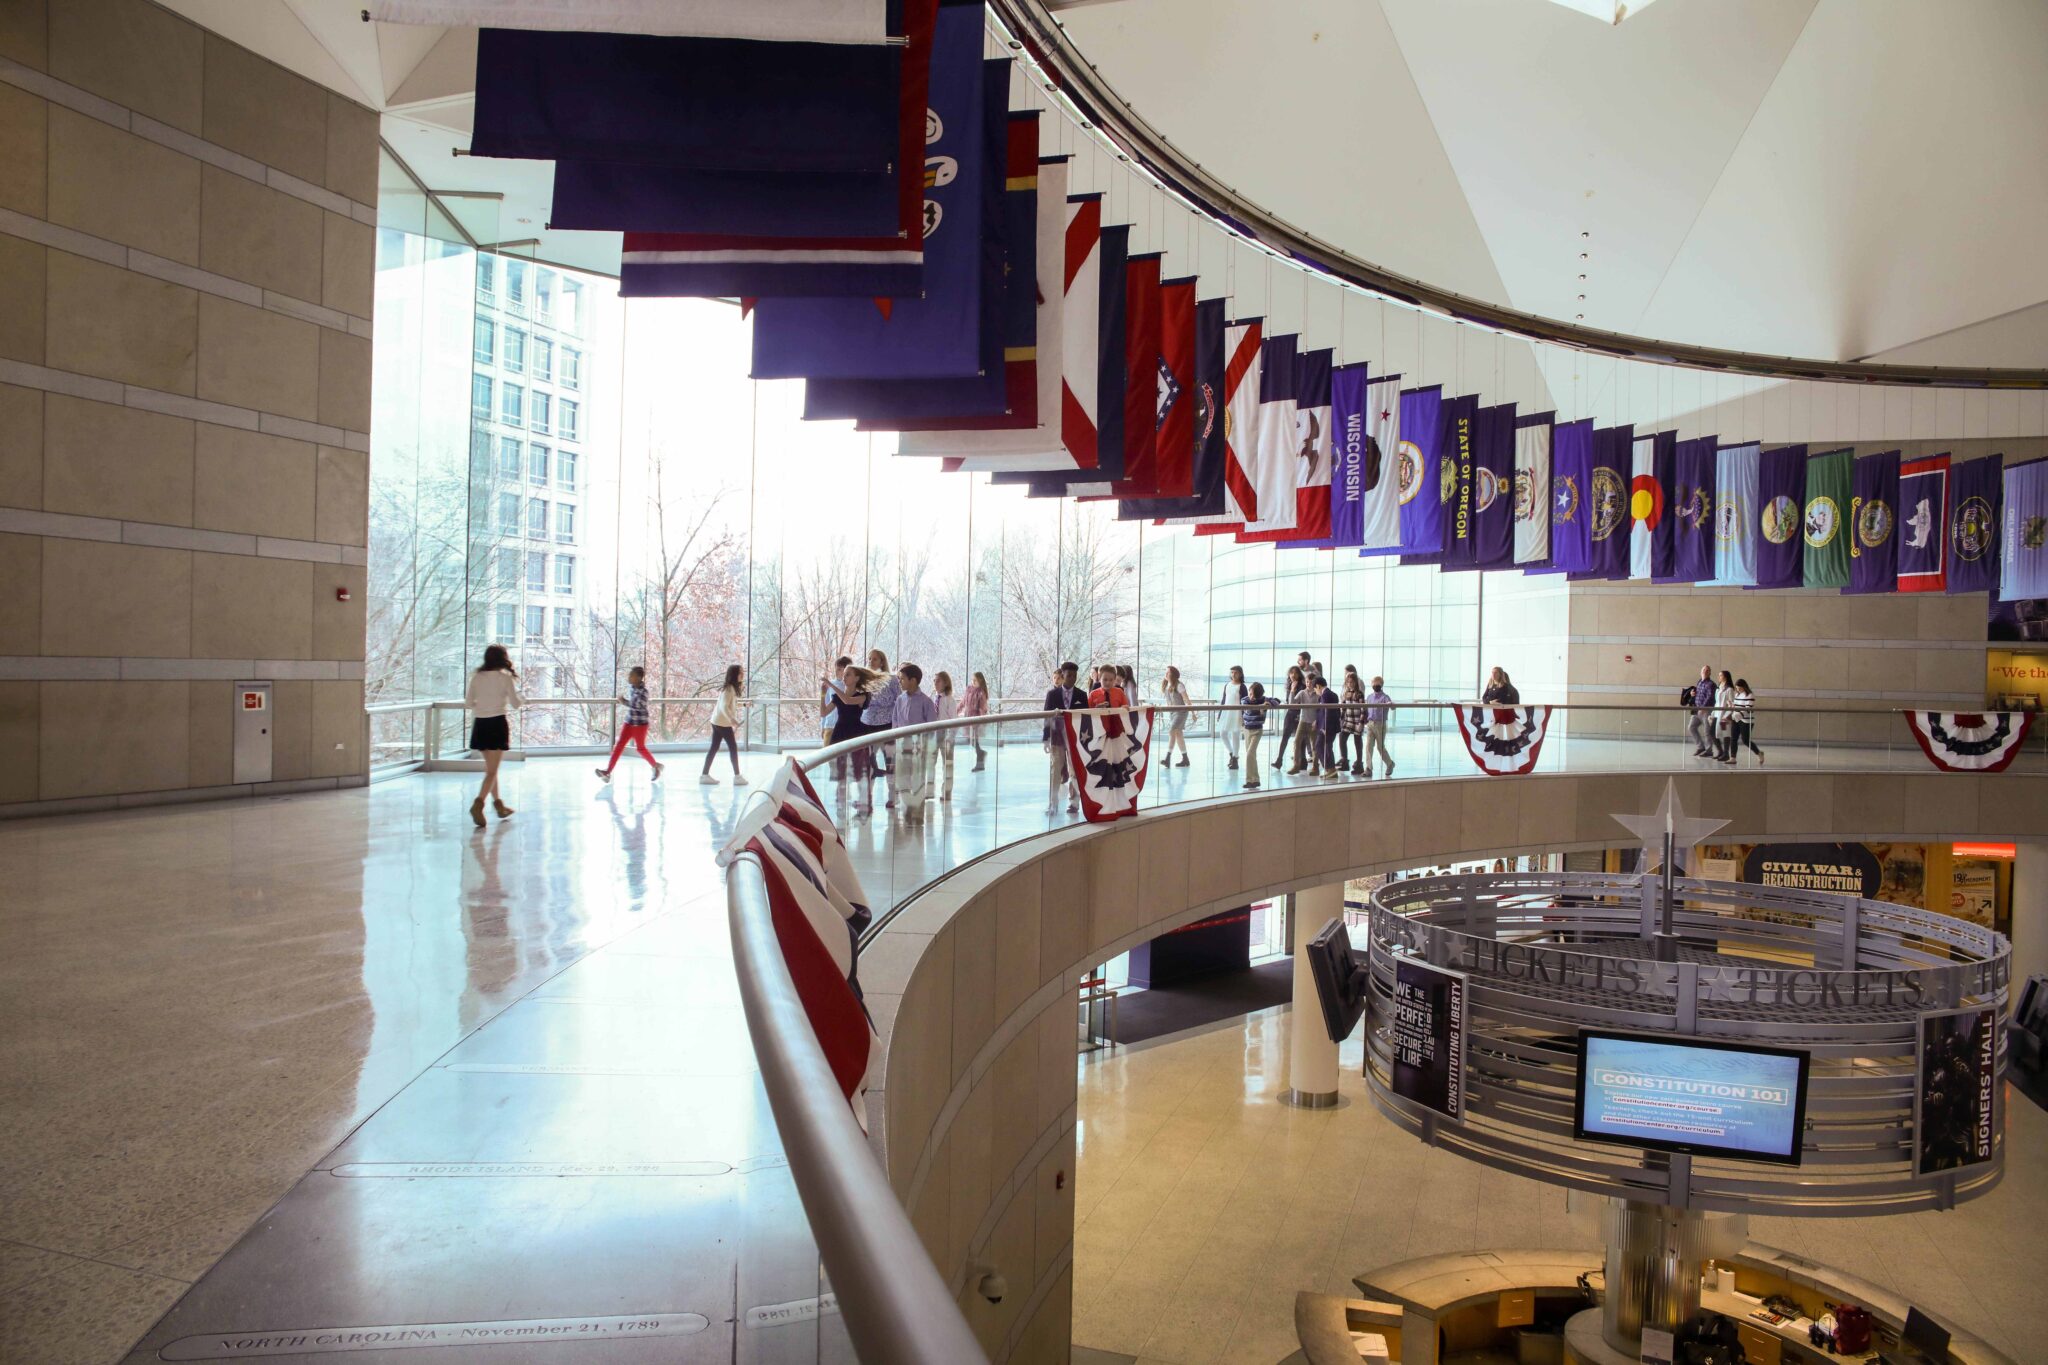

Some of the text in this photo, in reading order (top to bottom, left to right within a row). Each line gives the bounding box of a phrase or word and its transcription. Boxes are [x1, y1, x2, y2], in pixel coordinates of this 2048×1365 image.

[1347, 413, 1360, 501] WISCONSIN
[1457, 419, 1470, 538] STATE OF OREGON
[2007, 508, 2015, 564] OKLAHOMA
[1762, 861, 1863, 877] CIVIL WAR &
[1762, 873, 1863, 892] RECONSTRUCTION
[1468, 936, 1641, 995] TICKETS
[1397, 981, 1425, 999] WE THE
[1737, 970, 1925, 1007] TICKETS
[1394, 1032, 1423, 1052] SECURE
[1448, 982, 1462, 1114] CONSTITUTING LIBERTY
[1981, 1016, 1992, 1065] HALL
[1602, 1073, 1784, 1102] CONSTITUTION 101
[407, 1165, 473, 1173] RHODE
[478, 1165, 544, 1173] ISLAND
[218, 1320, 661, 1350] NORTH CAROLINA November 21, 1789
